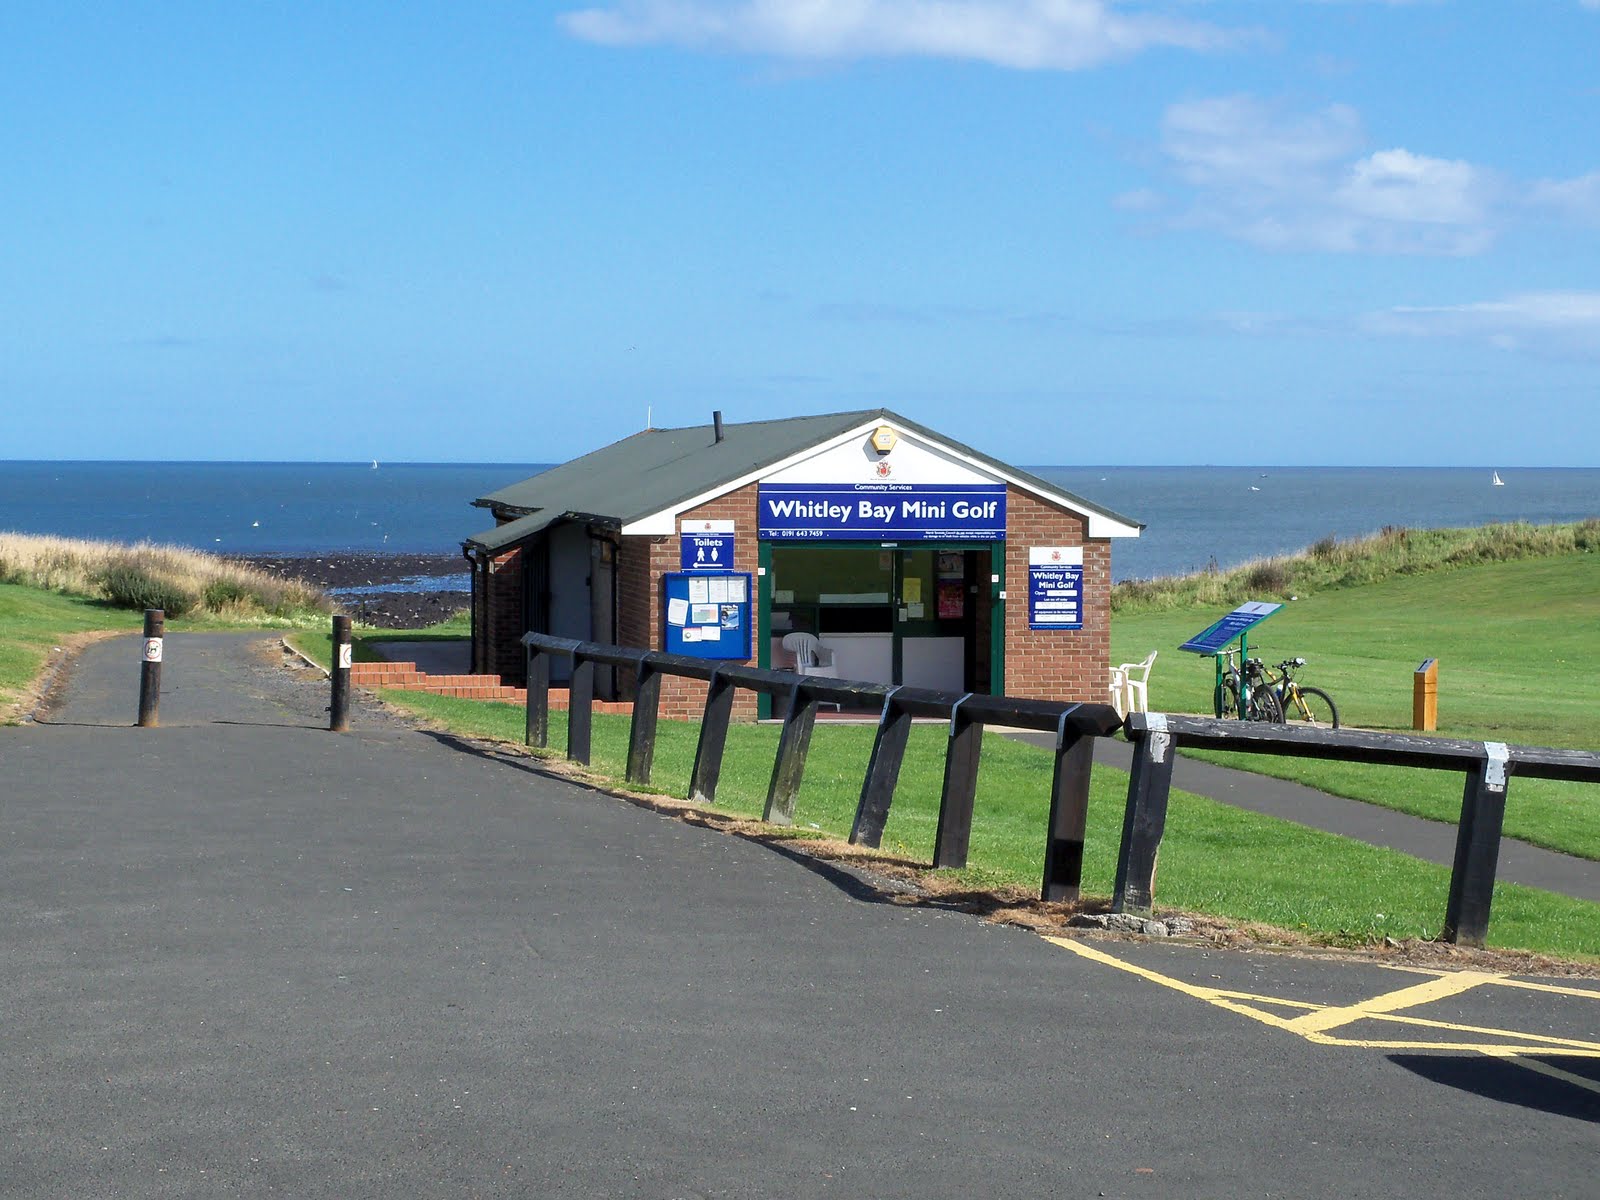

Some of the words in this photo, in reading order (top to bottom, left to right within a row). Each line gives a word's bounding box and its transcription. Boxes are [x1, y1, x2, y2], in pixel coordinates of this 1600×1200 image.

[768, 500, 852, 523] Whitley
[858, 500, 896, 523] Bay
[902, 501, 946, 518] Mini
[952, 501, 998, 519] Golf
[693, 538, 723, 546] Toilets
[1033, 572, 1064, 580] Whitley
[1065, 572, 1080, 580] Bay
